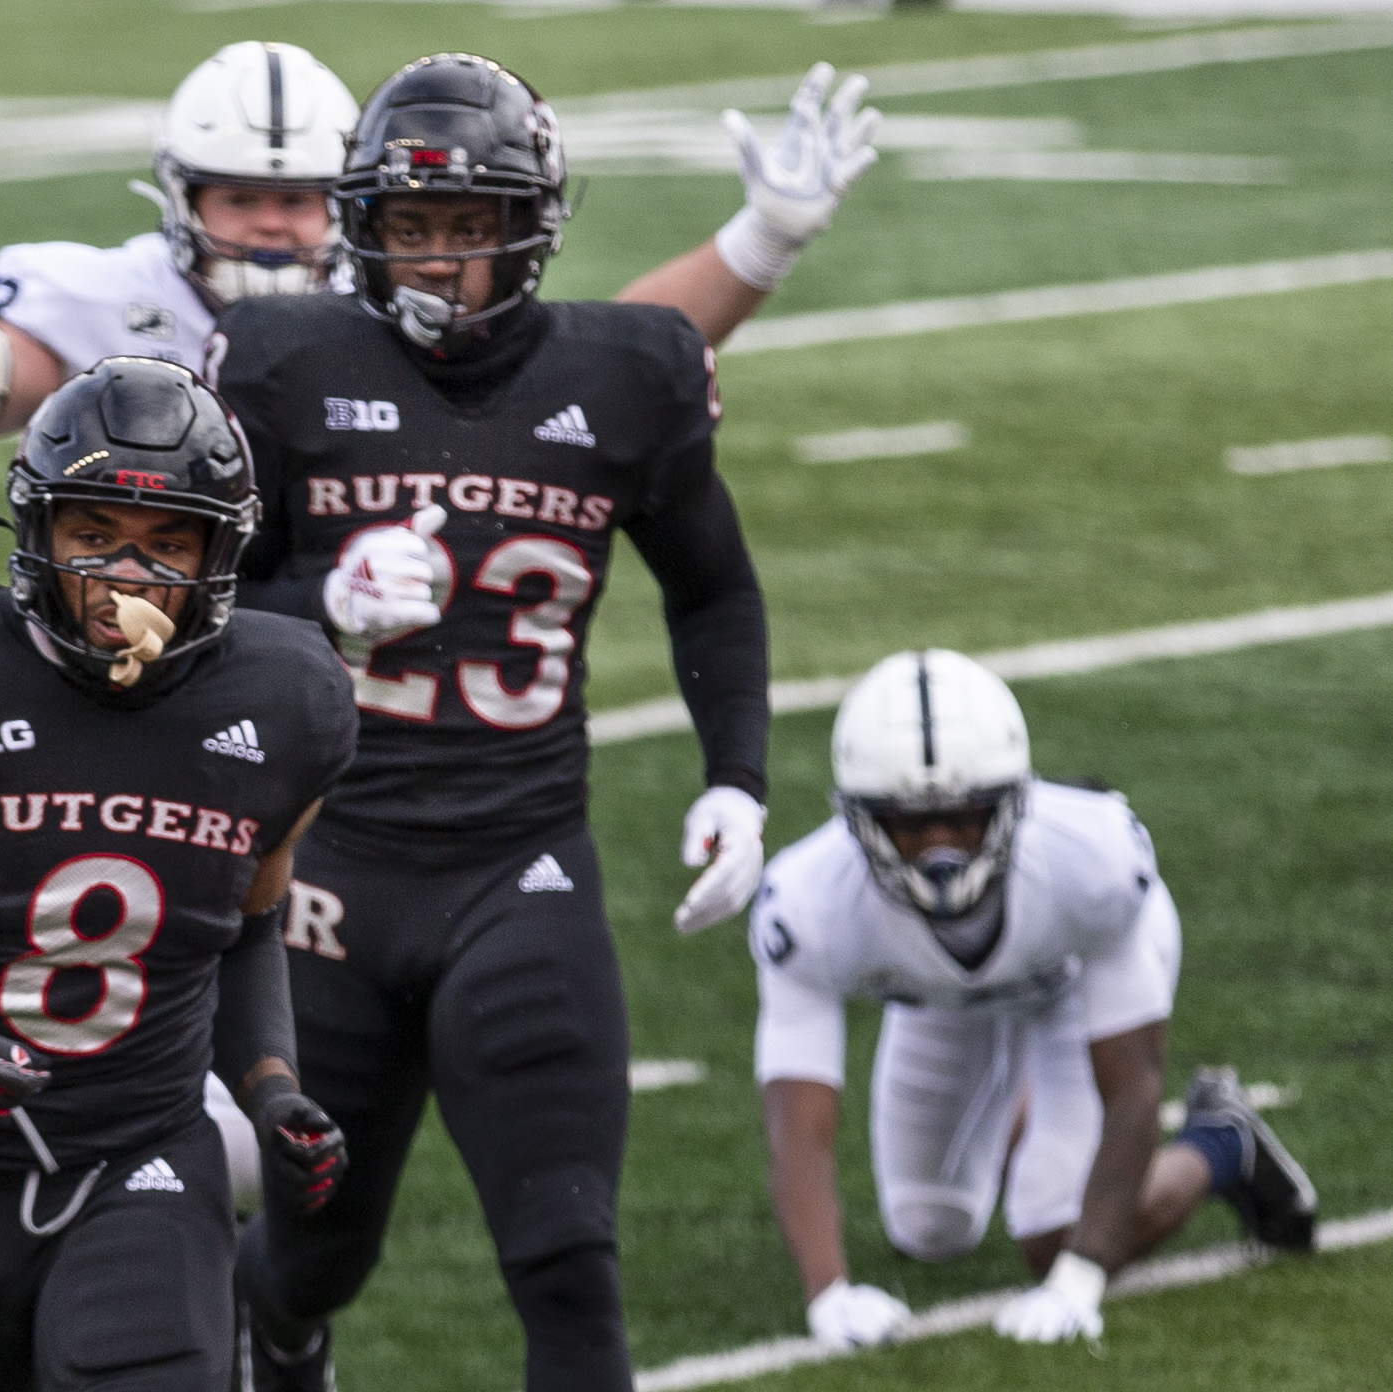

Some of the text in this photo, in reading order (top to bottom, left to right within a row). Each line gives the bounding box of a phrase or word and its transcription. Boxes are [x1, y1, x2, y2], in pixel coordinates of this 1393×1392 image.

[117, 469, 166, 490] FTC
[307, 473, 615, 530] RUTGERS
[334, 521, 595, 732] 23
[202, 738, 265, 764] adidas
[284, 879, 348, 961] R
[125, 1173, 185, 1193] adidas
